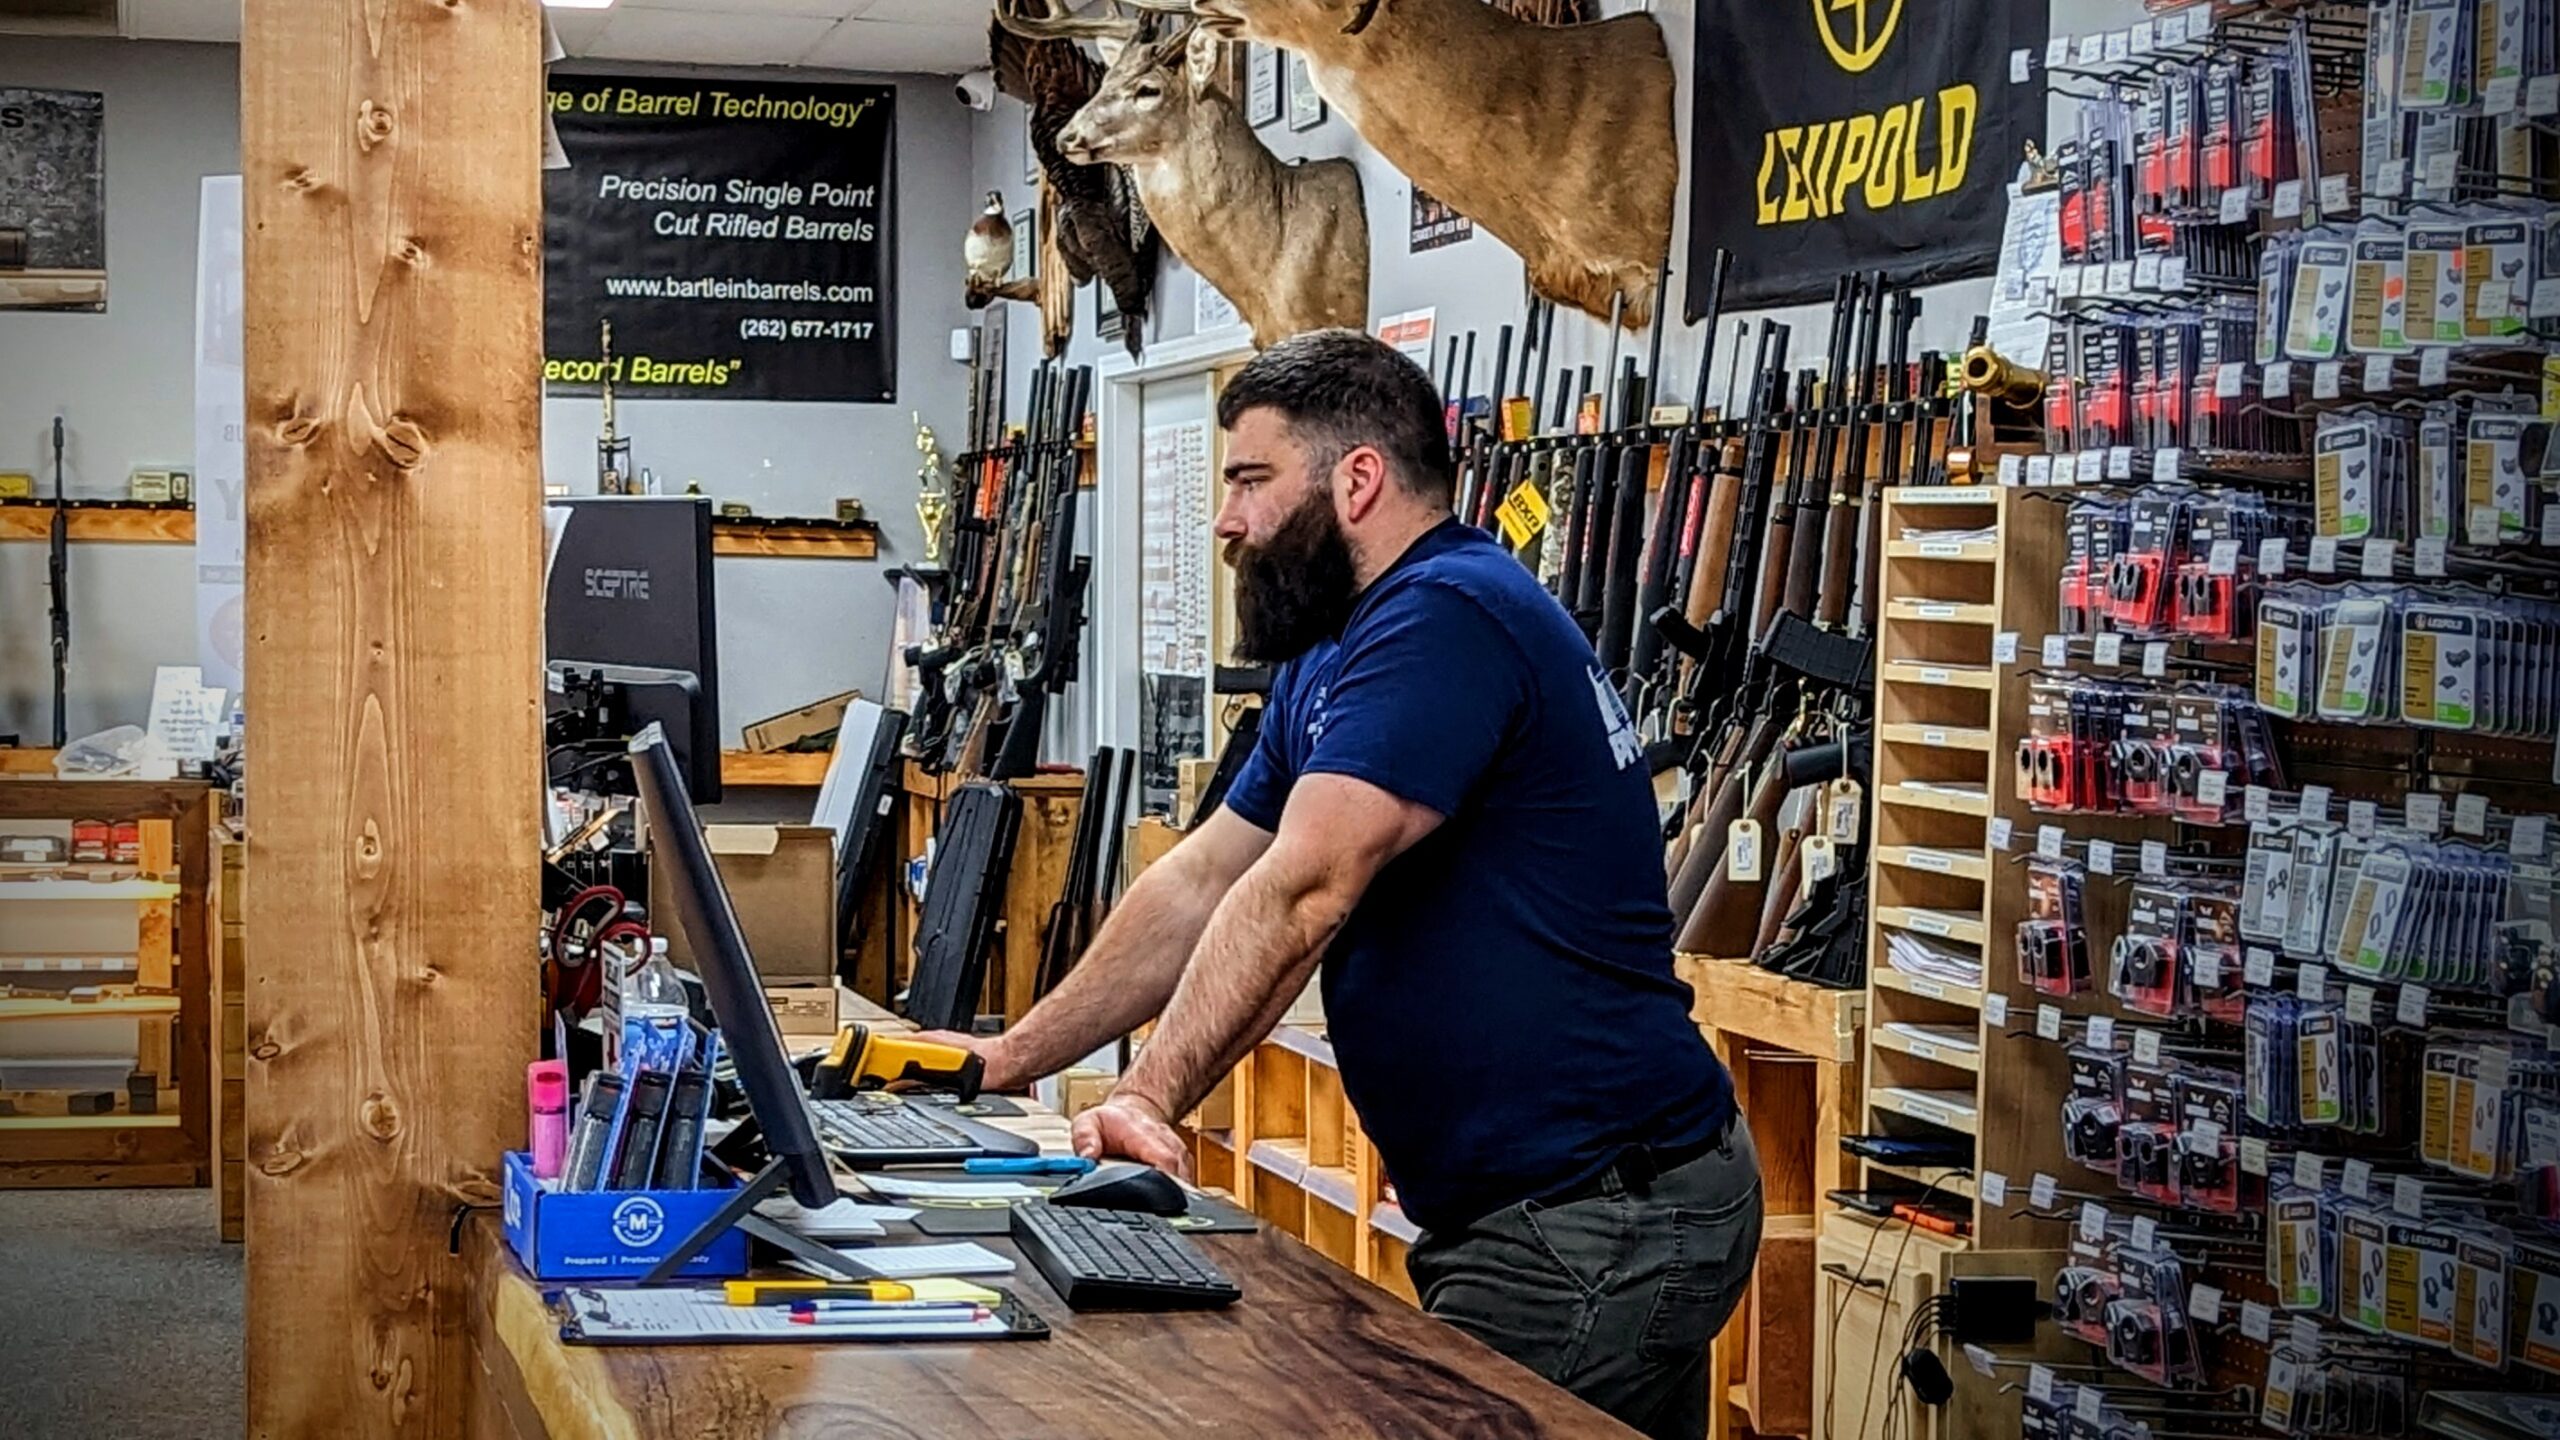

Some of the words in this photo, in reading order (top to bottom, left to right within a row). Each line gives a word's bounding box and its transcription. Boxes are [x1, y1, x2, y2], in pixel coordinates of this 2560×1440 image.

[582, 87, 613, 112] of
[616, 88, 700, 116] Barrel
[1756, 84, 1977, 225] LEUPOLD
[600, 175, 716, 202] Precision
[725, 179, 802, 209] Single
[809, 183, 874, 207] Point
[654, 211, 700, 236] Cut
[705, 213, 778, 238] Rifled
[785, 217, 874, 241] Barrels
[606, 277, 874, 302] www.bartleinbarrels.com
[740, 319, 787, 341] (262)
[791, 320, 874, 339] 677-1717
[584, 568, 649, 600] SCEPTRE
[629, 1212, 648, 1231] M
